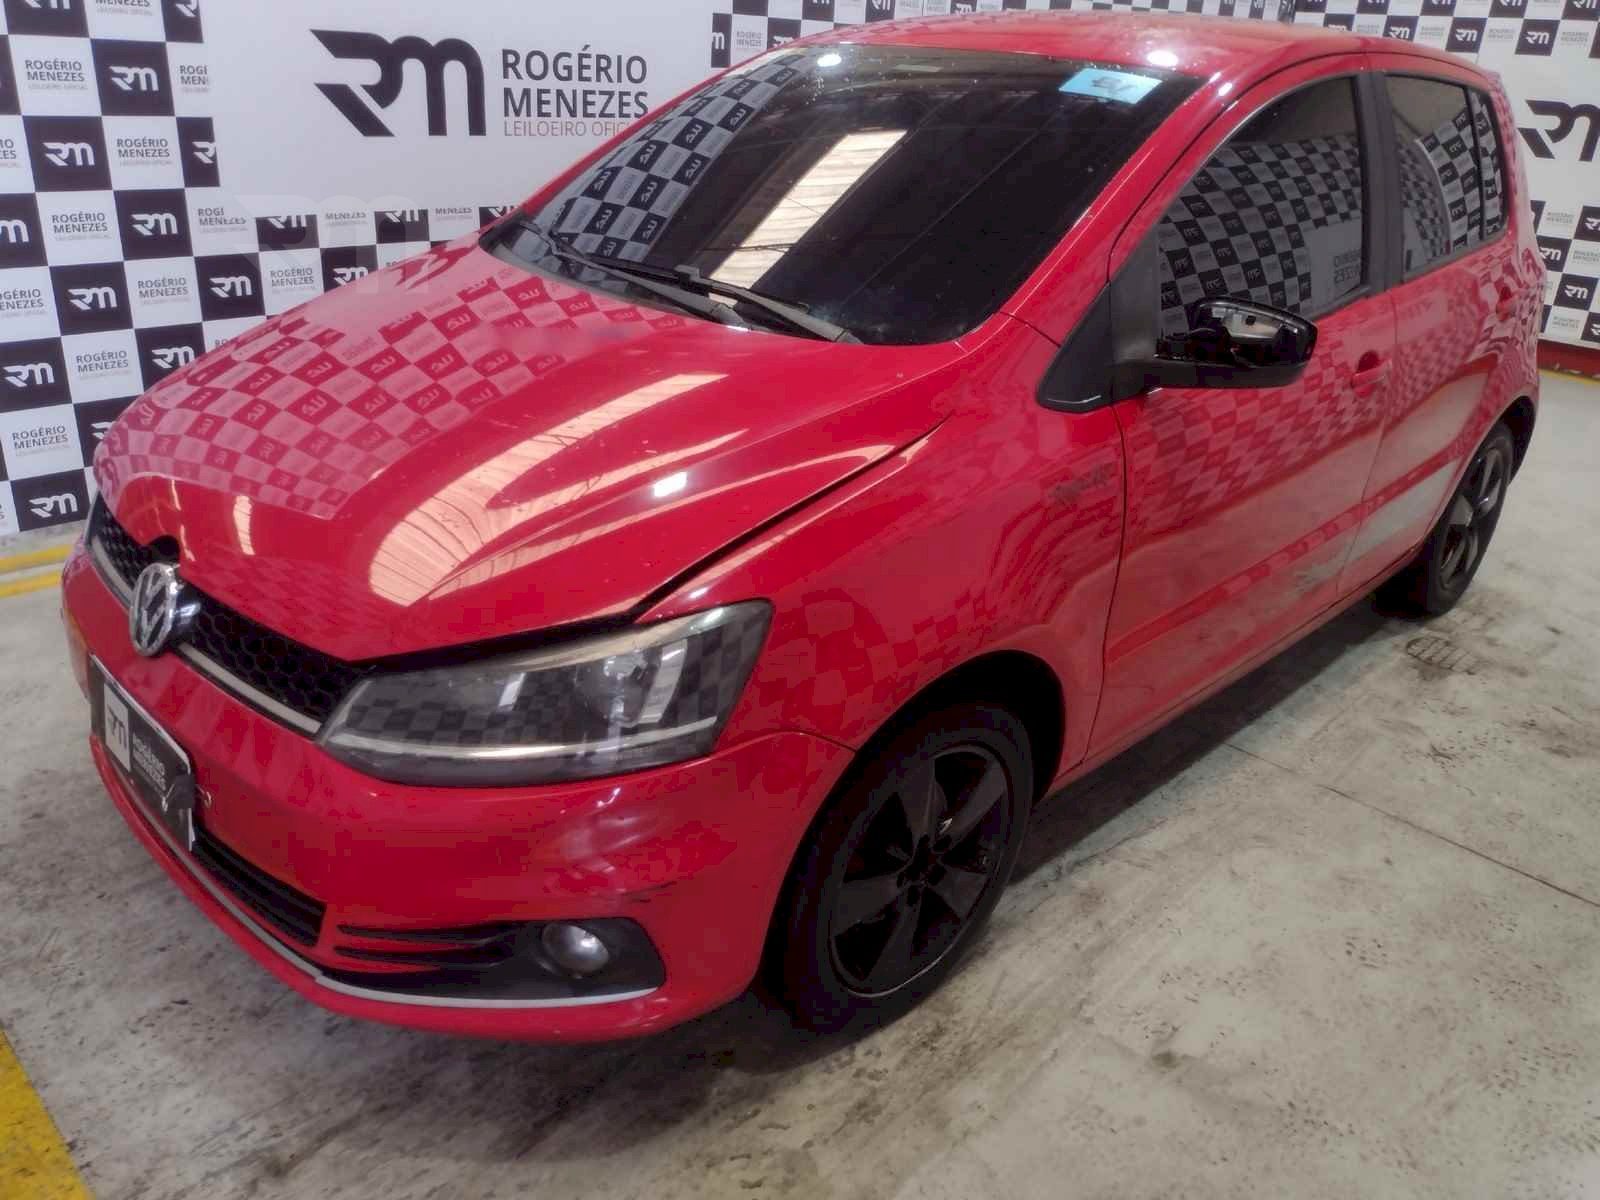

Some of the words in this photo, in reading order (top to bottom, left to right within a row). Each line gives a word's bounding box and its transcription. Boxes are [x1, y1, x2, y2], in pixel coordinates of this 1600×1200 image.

[25, 59, 82, 72] ROGÉRIO
[501, 44, 648, 84] ROGÉRIO
[26, 70, 85, 82] MENEZES
[503, 87, 649, 119] MENEZES
[504, 120, 587, 137] LEILOEIRO
[117, 136, 169, 149] ROGÉRIO
[118, 147, 171, 159] MENEZES
[51, 212, 106, 225] ROGÉRIO
[53, 222, 109, 234] MENEZES
[269, 267, 313, 278] ROGÉRIO
[138, 276, 187, 289] ROGÉRIO
[271, 276, 314, 288] MENEZES
[138, 286, 189, 299] MENEZES
[76, 350, 127, 365] ROGÉRIO
[77, 359, 129, 373] MENEZES
[12, 424, 66, 441] ROGÉRIO
[13, 434, 68, 450] MENEZES
